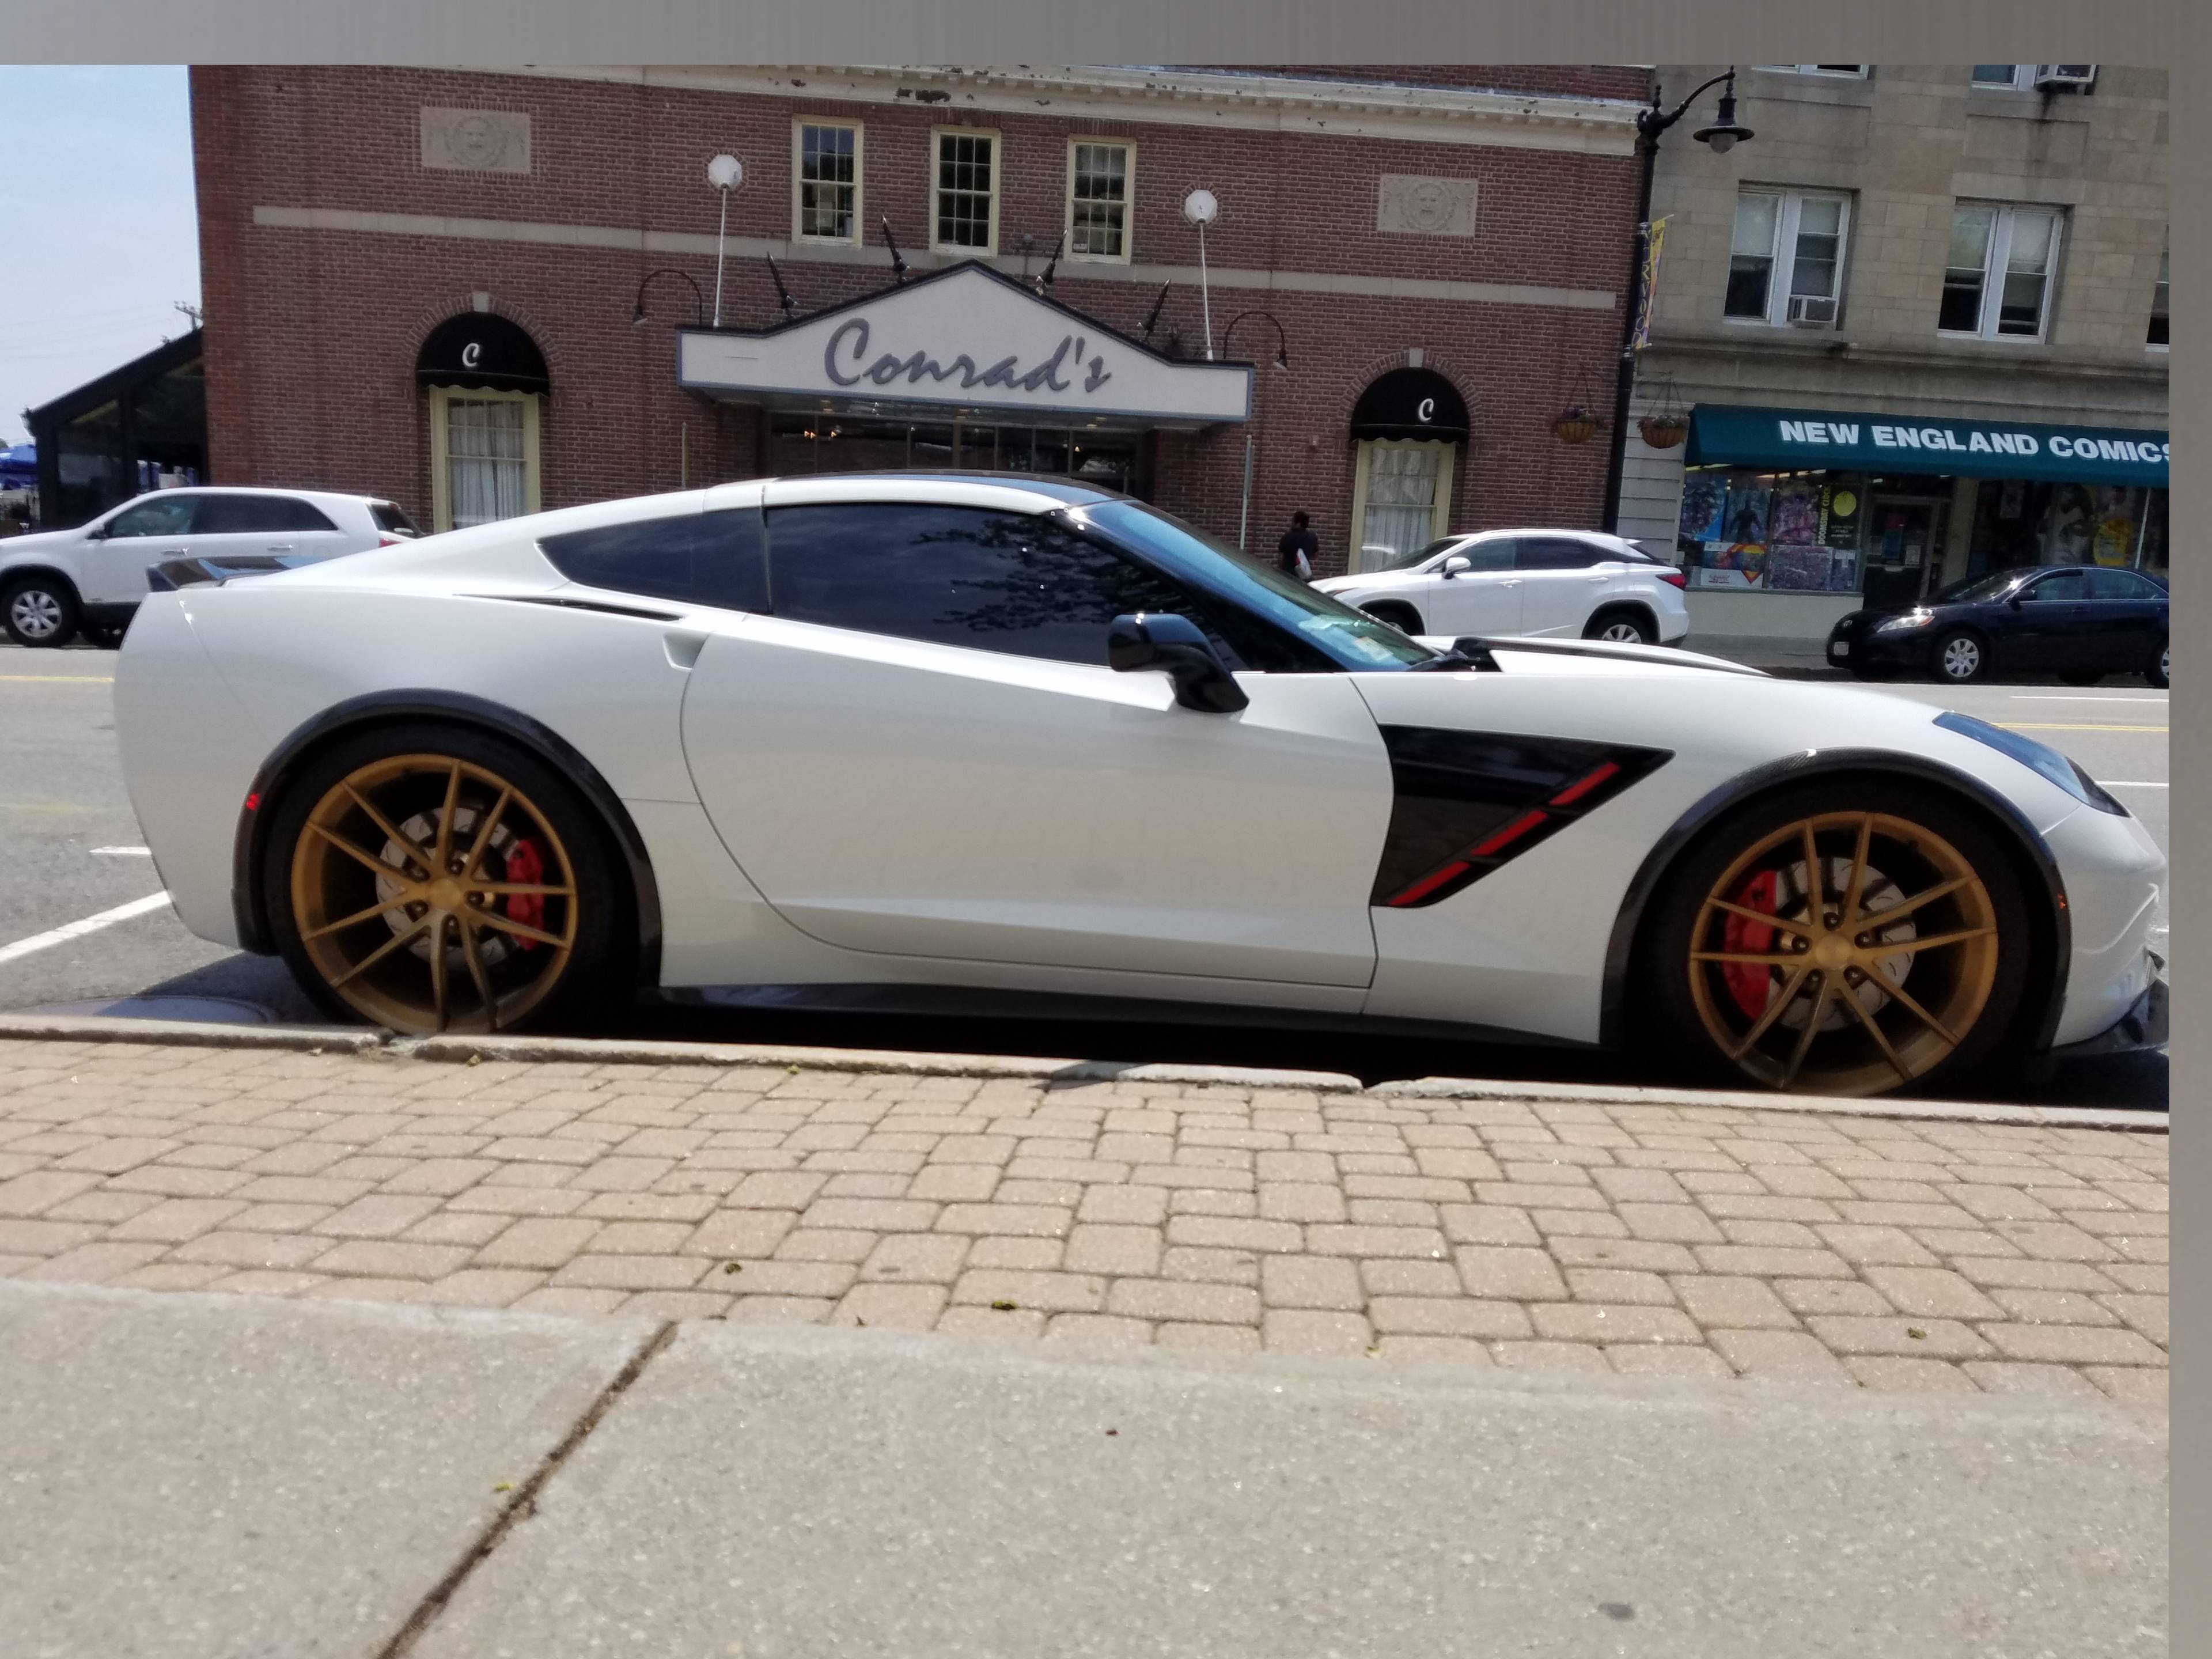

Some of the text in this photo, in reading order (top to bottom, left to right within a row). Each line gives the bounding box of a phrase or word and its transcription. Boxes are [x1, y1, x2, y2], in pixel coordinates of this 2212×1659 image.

[461, 342, 480, 368] C
[824, 317, 1112, 393] Conrad's
[1417, 397, 1434, 423] C
[1779, 420, 1860, 445] NEW
[1872, 425, 2039, 455] ENGLAND
[1818, 486, 1832, 544] DOOMSDAY CLOC
